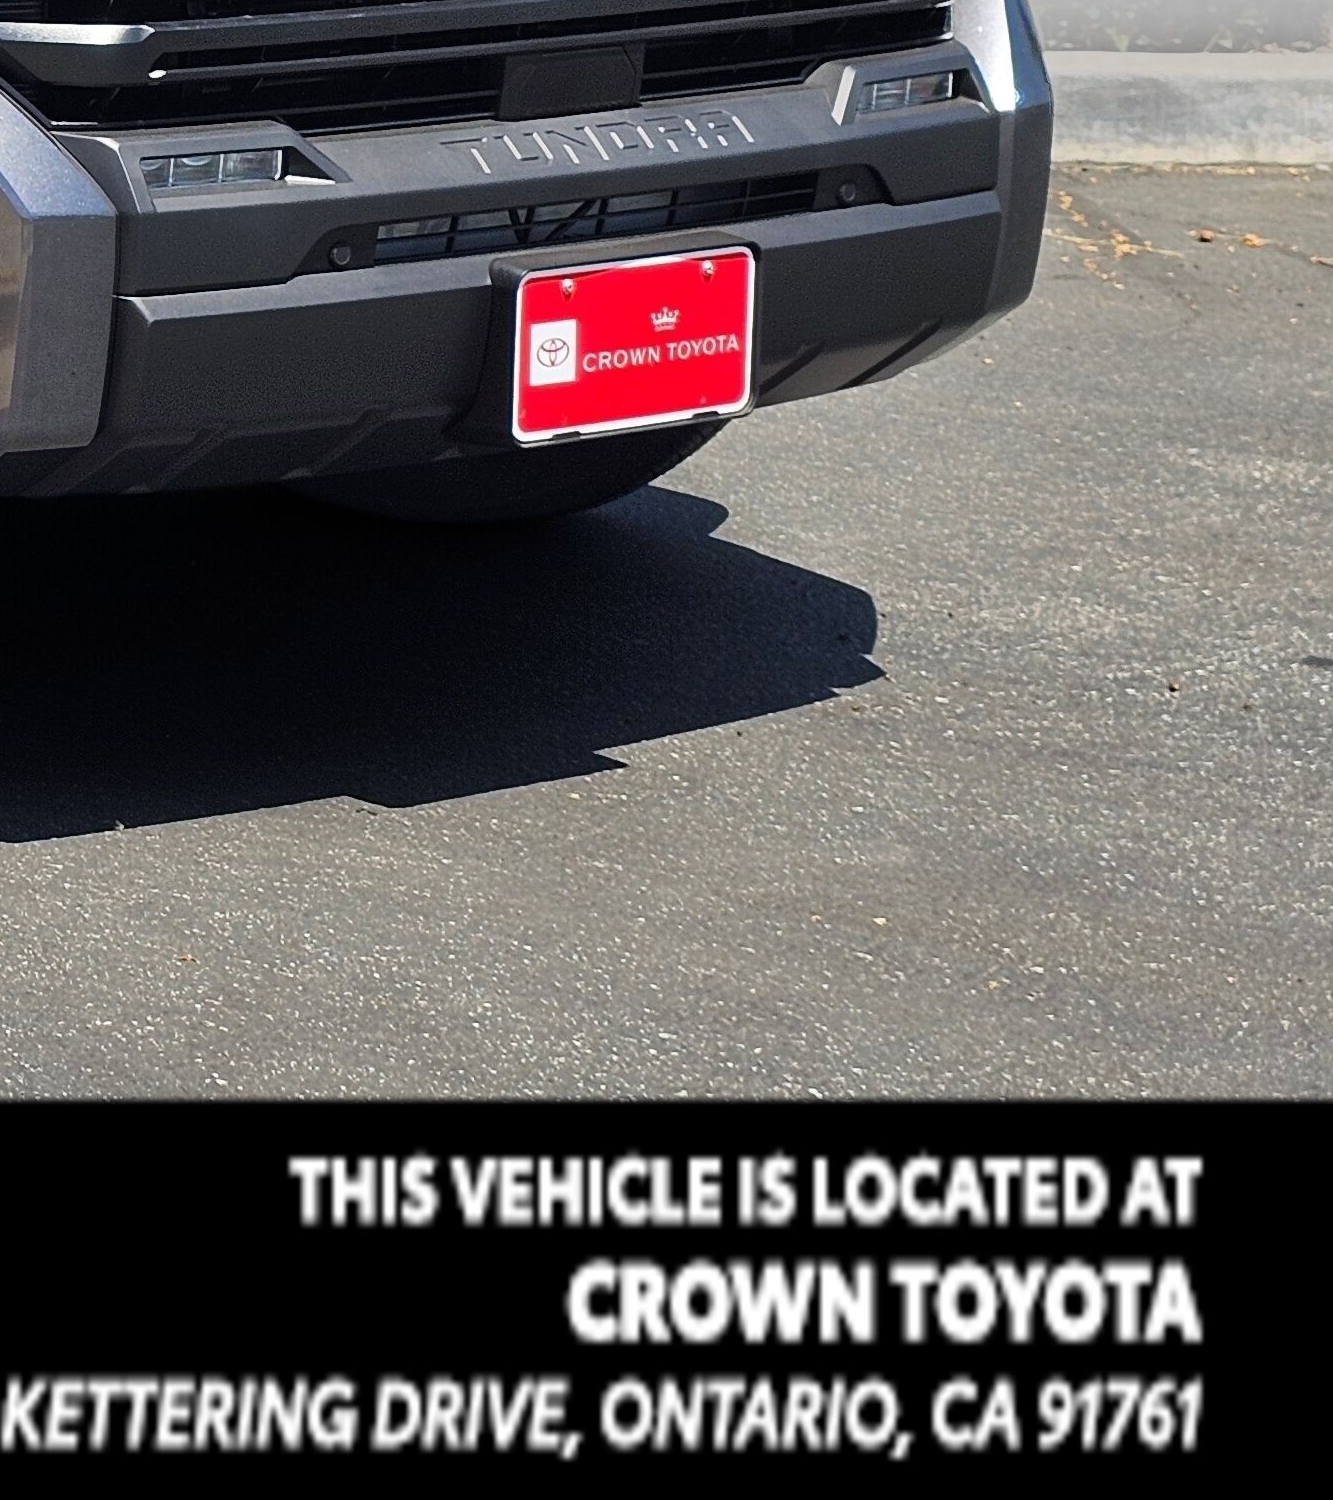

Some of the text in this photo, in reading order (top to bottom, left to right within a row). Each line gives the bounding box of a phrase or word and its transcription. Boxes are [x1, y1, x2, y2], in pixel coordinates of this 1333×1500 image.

[439, 110, 756, 175] TUNDRA
[582, 333, 740, 374] CROWN TOYOTA
